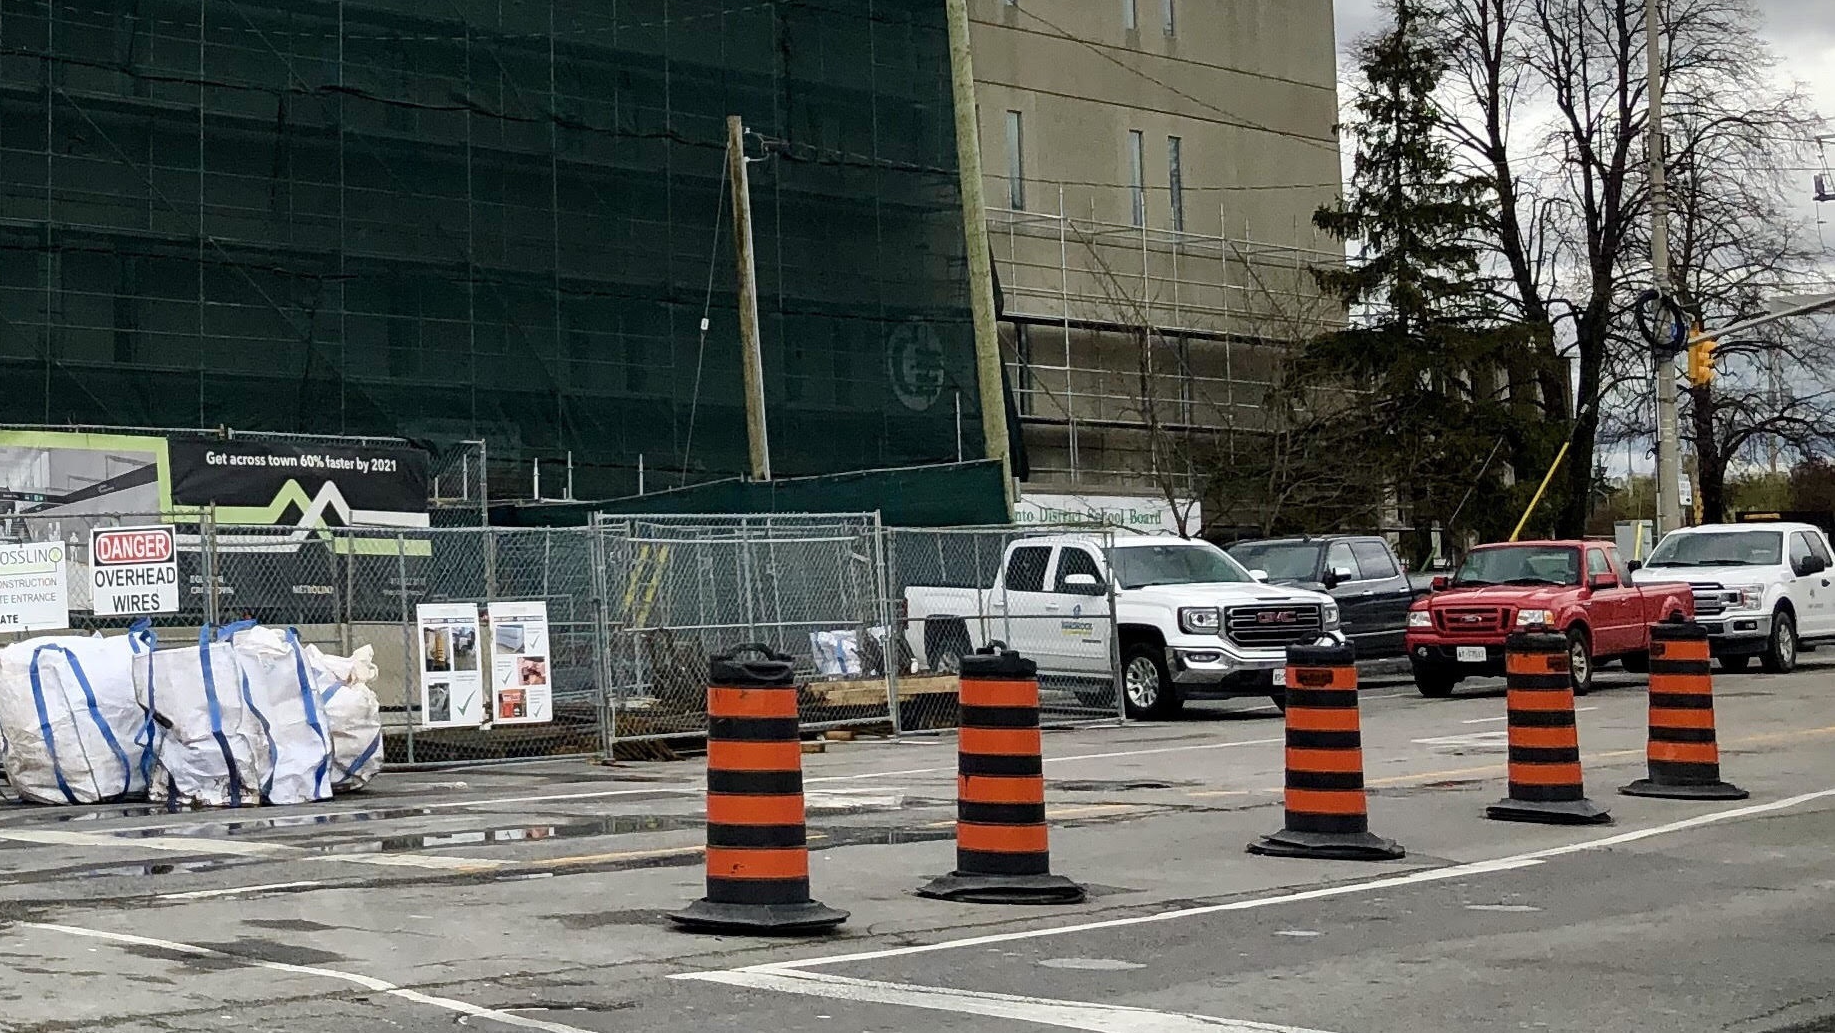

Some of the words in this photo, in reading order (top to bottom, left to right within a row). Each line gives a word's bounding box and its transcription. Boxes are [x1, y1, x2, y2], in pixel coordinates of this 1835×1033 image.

[205, 451, 227, 465] Get
[229, 454, 266, 466] across
[268, 455, 297, 467] town
[300, 454, 324, 468] 60%
[325, 455, 354, 470] faster
[356, 456, 369, 474] by
[371, 458, 397, 472] 2021
[1129, 508, 1162, 525] Board
[99, 534, 167, 561] DANGER
[94, 567, 176, 588] OVERHEAD
[11, 592, 57, 605] ENTRANCE
[112, 593, 161, 613] WIRES
[1257, 611, 1297, 623] GMC
